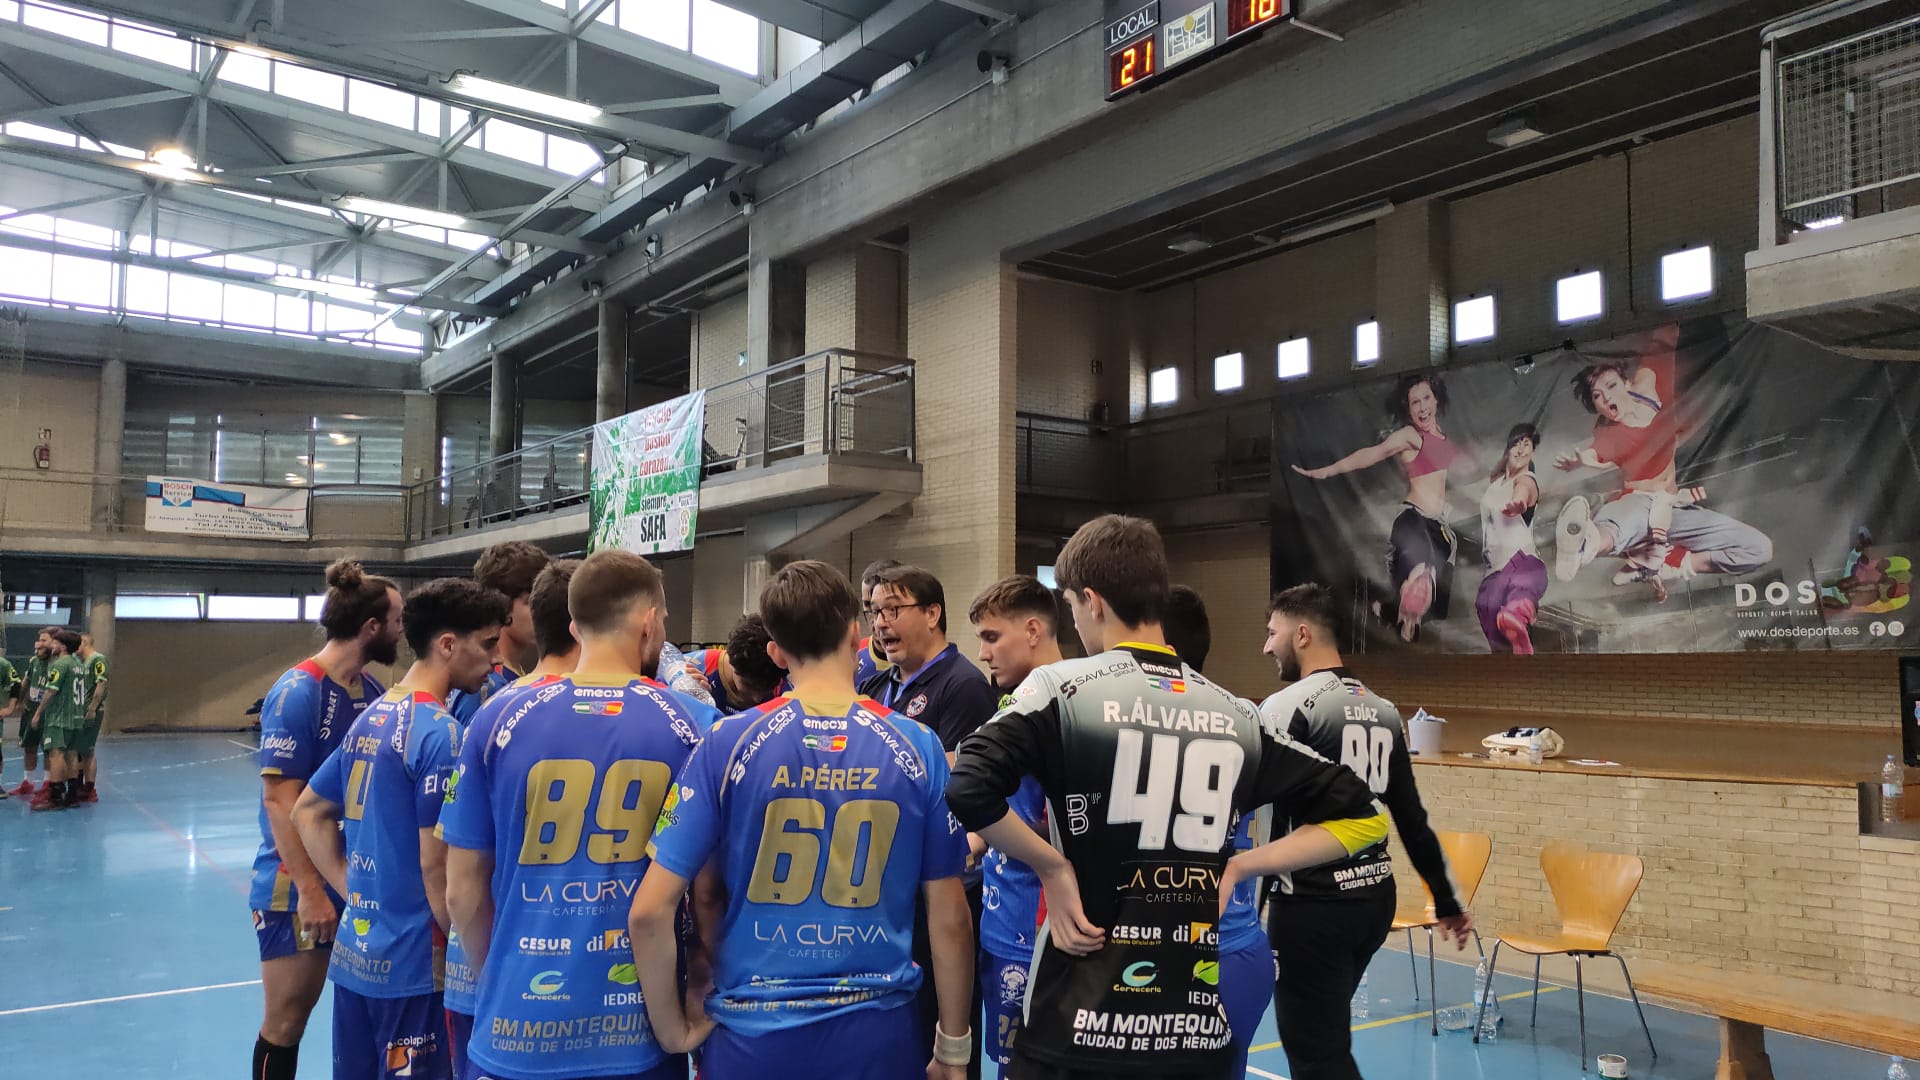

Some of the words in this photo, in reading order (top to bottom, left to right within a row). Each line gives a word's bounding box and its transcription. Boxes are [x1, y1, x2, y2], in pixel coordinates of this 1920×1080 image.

[1110, 9, 1154, 44] LOCAL
[1121, 41, 1151, 86] 21
[164, 483, 193, 491] BOSCH
[641, 495, 667, 512] siempre
[640, 513, 667, 543] SAFA
[1735, 580, 1816, 607] DOS
[1738, 626, 1860, 638] www.dosdeporte.es
[1075, 660, 1134, 687] SAVILCON
[506, 683, 564, 730] SAVILCON
[650, 693, 700, 744] SAVILCON
[742, 705, 794, 764] SAVILCON
[870, 722, 923, 779] SAVILCON
[1107, 728, 1245, 854] 49
[519, 759, 672, 866] 89
[351, 851, 377, 872] RVA
[746, 797, 900, 908] 60
[1154, 866, 1219, 889] CURV
[1333, 867, 1354, 882] BM
[522, 882, 554, 903] LA
[562, 879, 637, 903] CURV
[519, 937, 572, 951] CESUR
[586, 931, 631, 953] diTe
[754, 920, 788, 943] LA
[796, 923, 888, 945] CURVA
[1112, 925, 1162, 939] CESUR
[333, 941, 392, 975] ONTEQUINTO
[1188, 991, 1218, 1007] IEDR
[492, 1017, 518, 1037] BM
[523, 1013, 649, 1040] MONTEQUIN
[1073, 1008, 1110, 1032] BM
[492, 1036, 534, 1053] CIUDAD
[540, 1041, 559, 1053] DE
[564, 1037, 593, 1051] DOS
[599, 1032, 648, 1047] HERMA
[1073, 1035, 1126, 1050] CIUDAD
[1131, 1036, 1150, 1051] DE
[1154, 1036, 1178, 1051] DOS
[1183, 1026, 1231, 1051] HERMA
